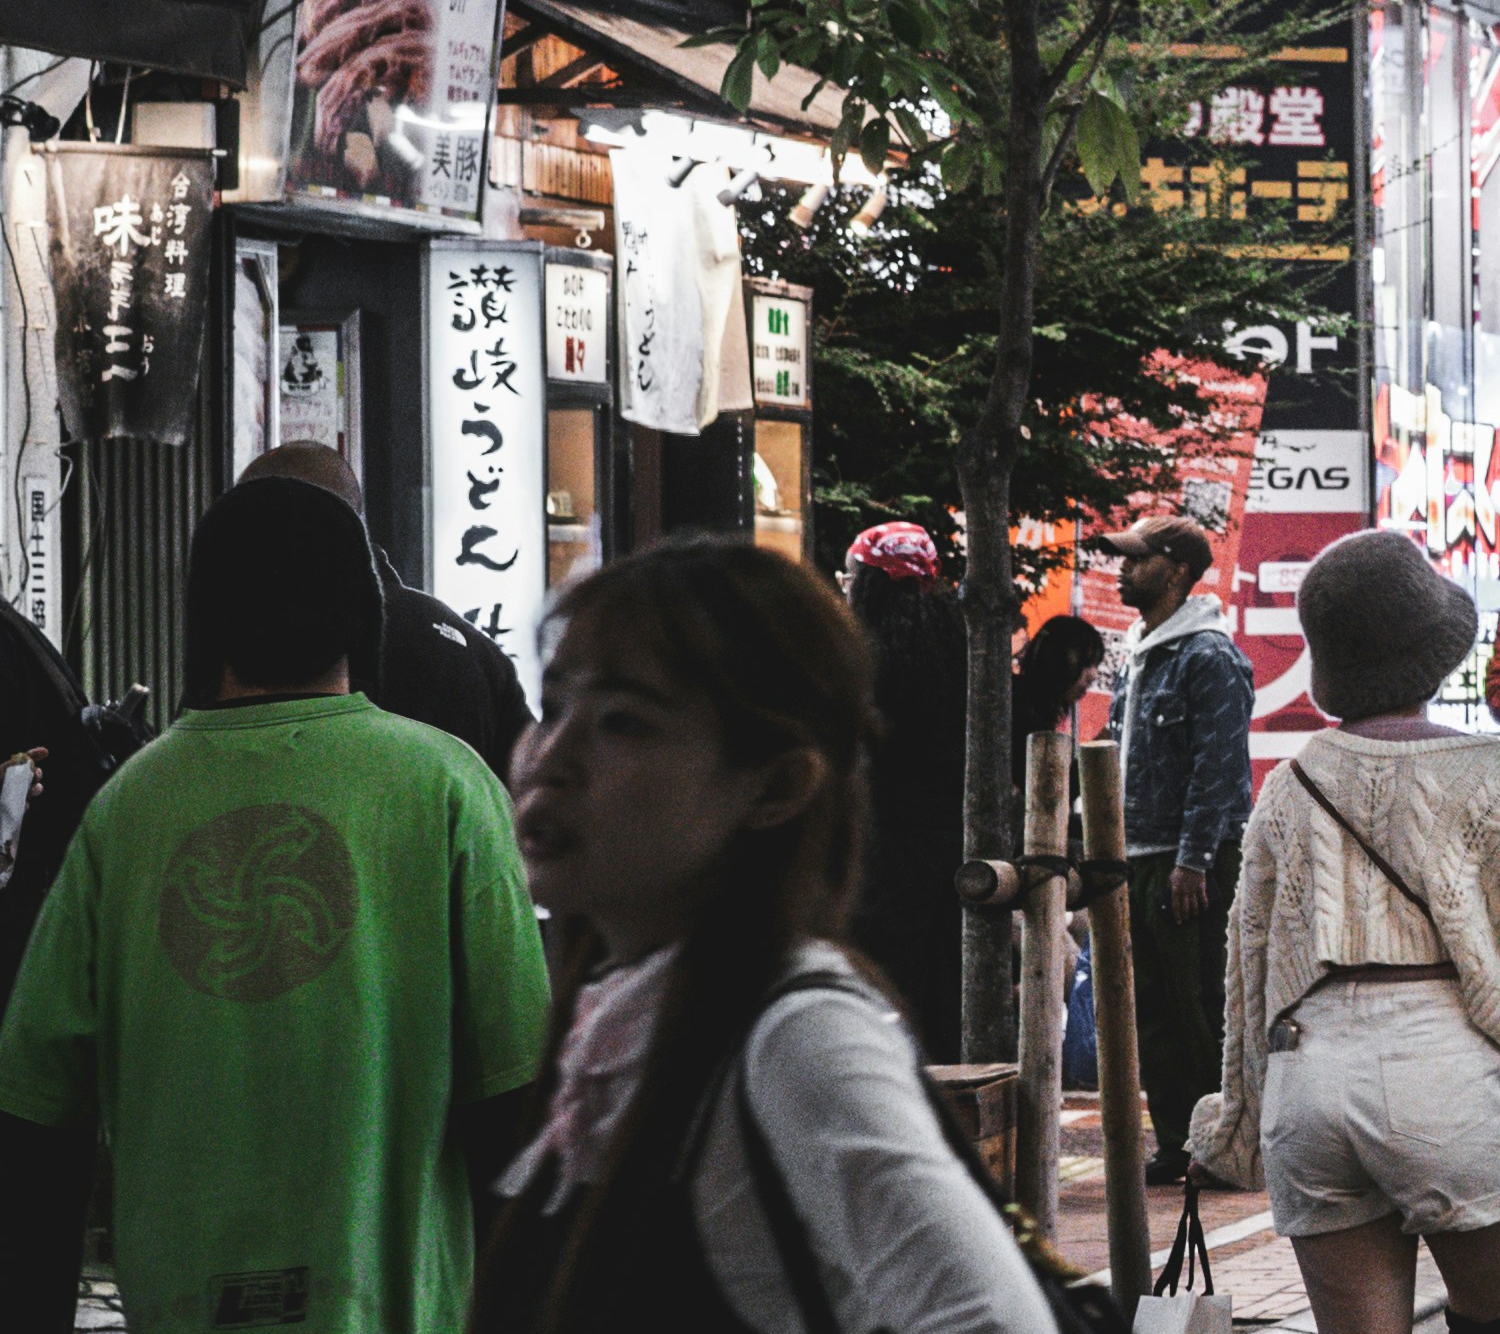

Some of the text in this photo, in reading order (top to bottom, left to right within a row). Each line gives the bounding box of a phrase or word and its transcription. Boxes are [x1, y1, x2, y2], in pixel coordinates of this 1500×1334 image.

[447, 264, 521, 572] 讃岐うどん
